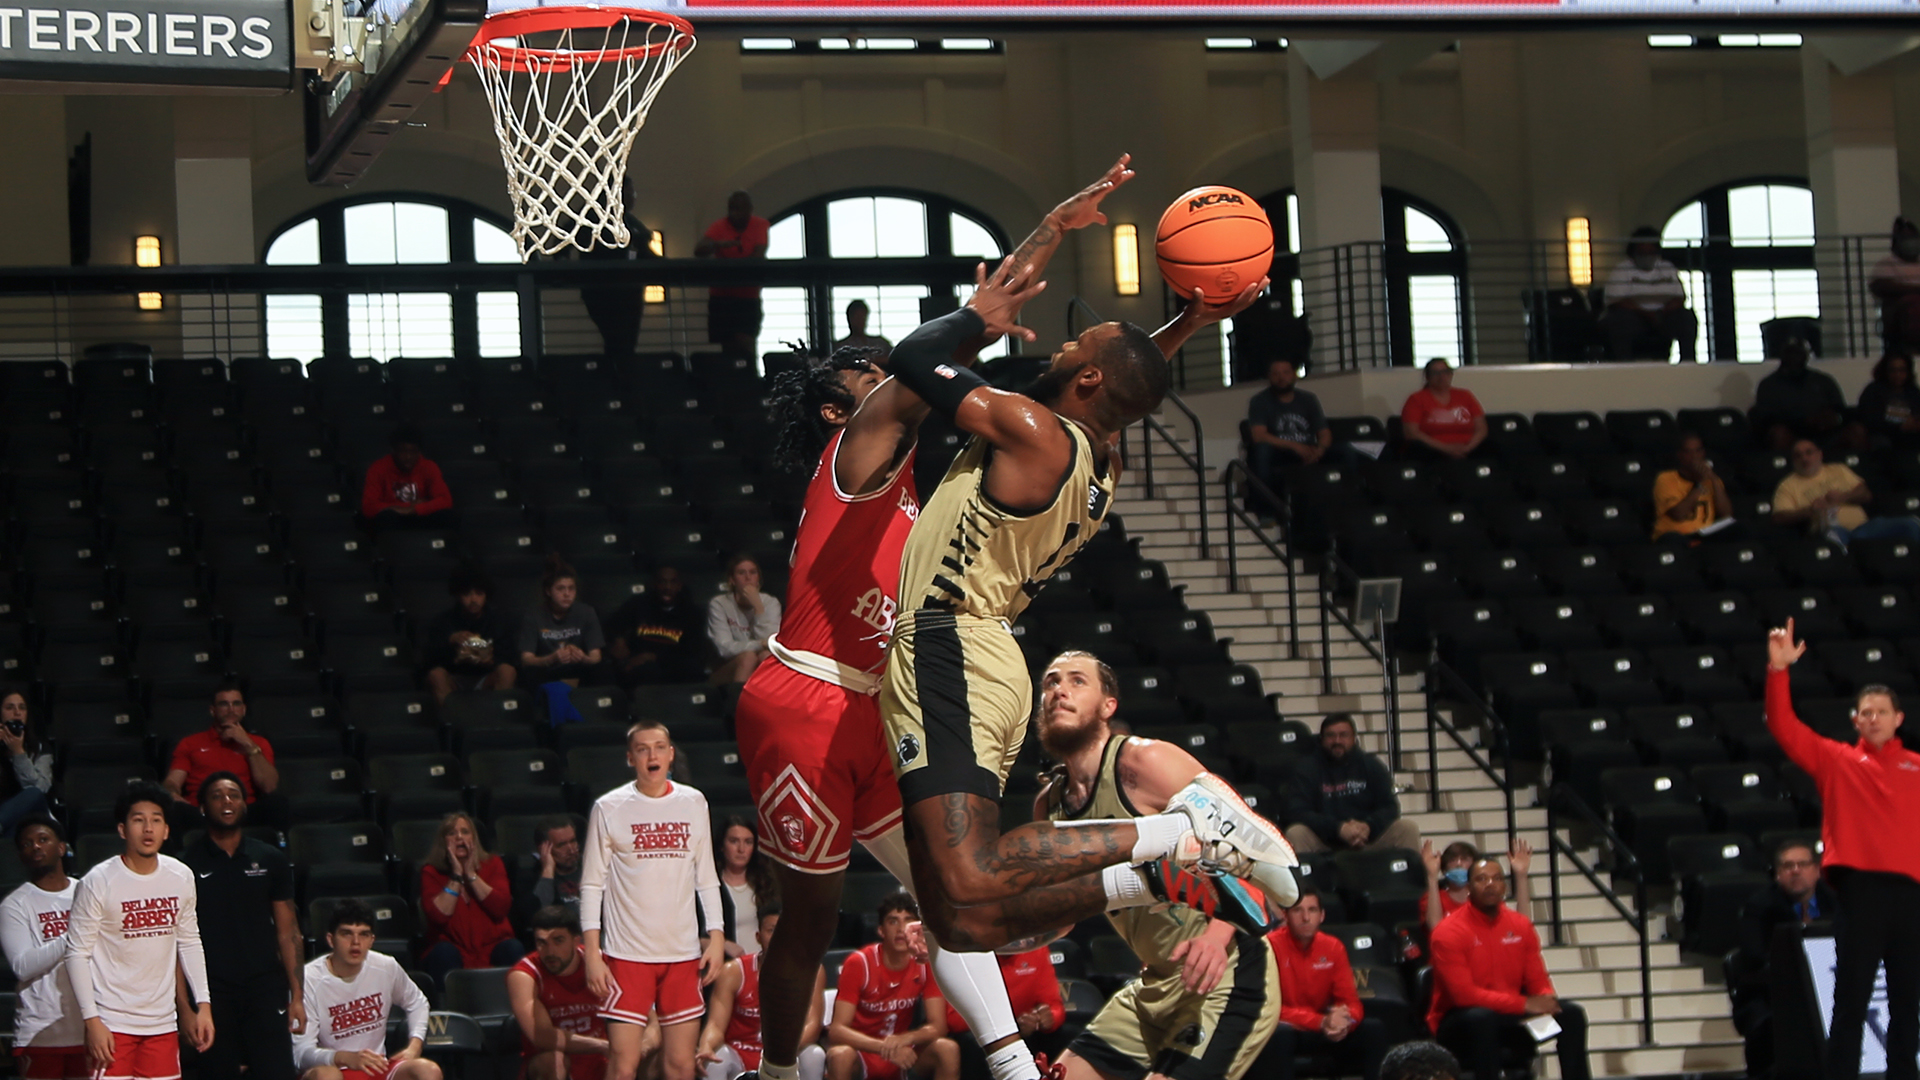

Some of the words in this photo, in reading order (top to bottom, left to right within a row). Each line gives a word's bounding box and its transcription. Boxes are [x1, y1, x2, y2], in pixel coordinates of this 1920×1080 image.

[0, 8, 274, 59] TERRIERS
[1188, 193, 1245, 213] NCAA
[631, 822, 690, 834] BELMONT
[633, 833, 691, 849] ABBEY
[121, 897, 179, 913] BELMONT
[122, 909, 179, 929] ABBEY
[328, 992, 382, 1017] BELMONT
[332, 1002, 383, 1032] ABBEY
[428, 1015, 450, 1035] W
